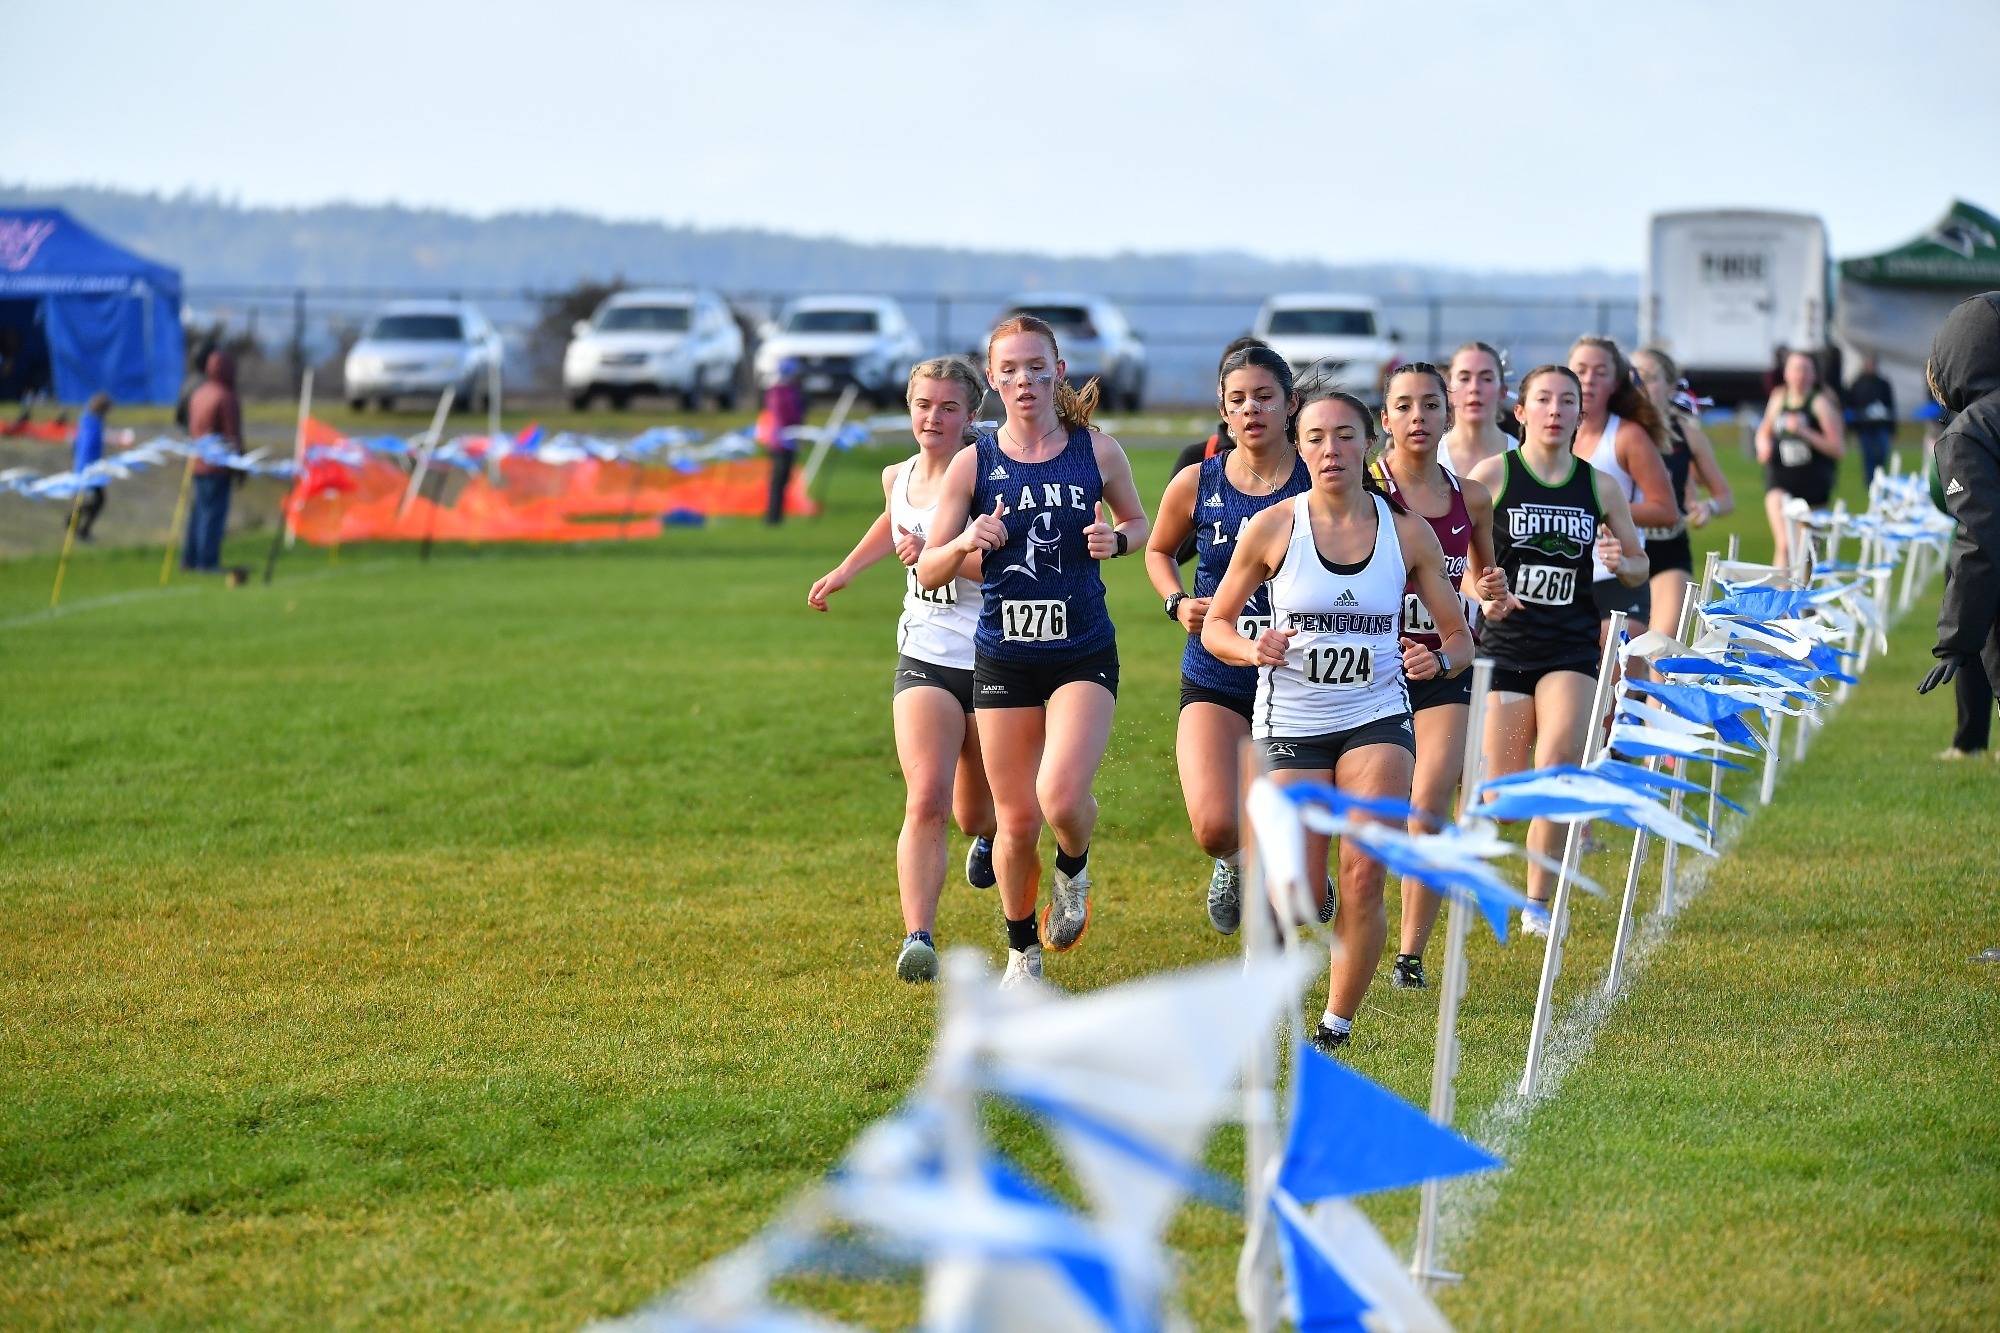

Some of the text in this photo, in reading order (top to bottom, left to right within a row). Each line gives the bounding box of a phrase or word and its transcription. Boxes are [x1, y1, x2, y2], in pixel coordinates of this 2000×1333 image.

[994, 483, 1086, 516] LANE
[1212, 516, 1250, 546] LA
[1512, 511, 1592, 541] GATORS
[1519, 568, 1573, 601] 1260
[1006, 603, 1064, 638] 1276
[1287, 612, 1394, 636] PENGUINS
[1307, 646, 1371, 685] 1224
